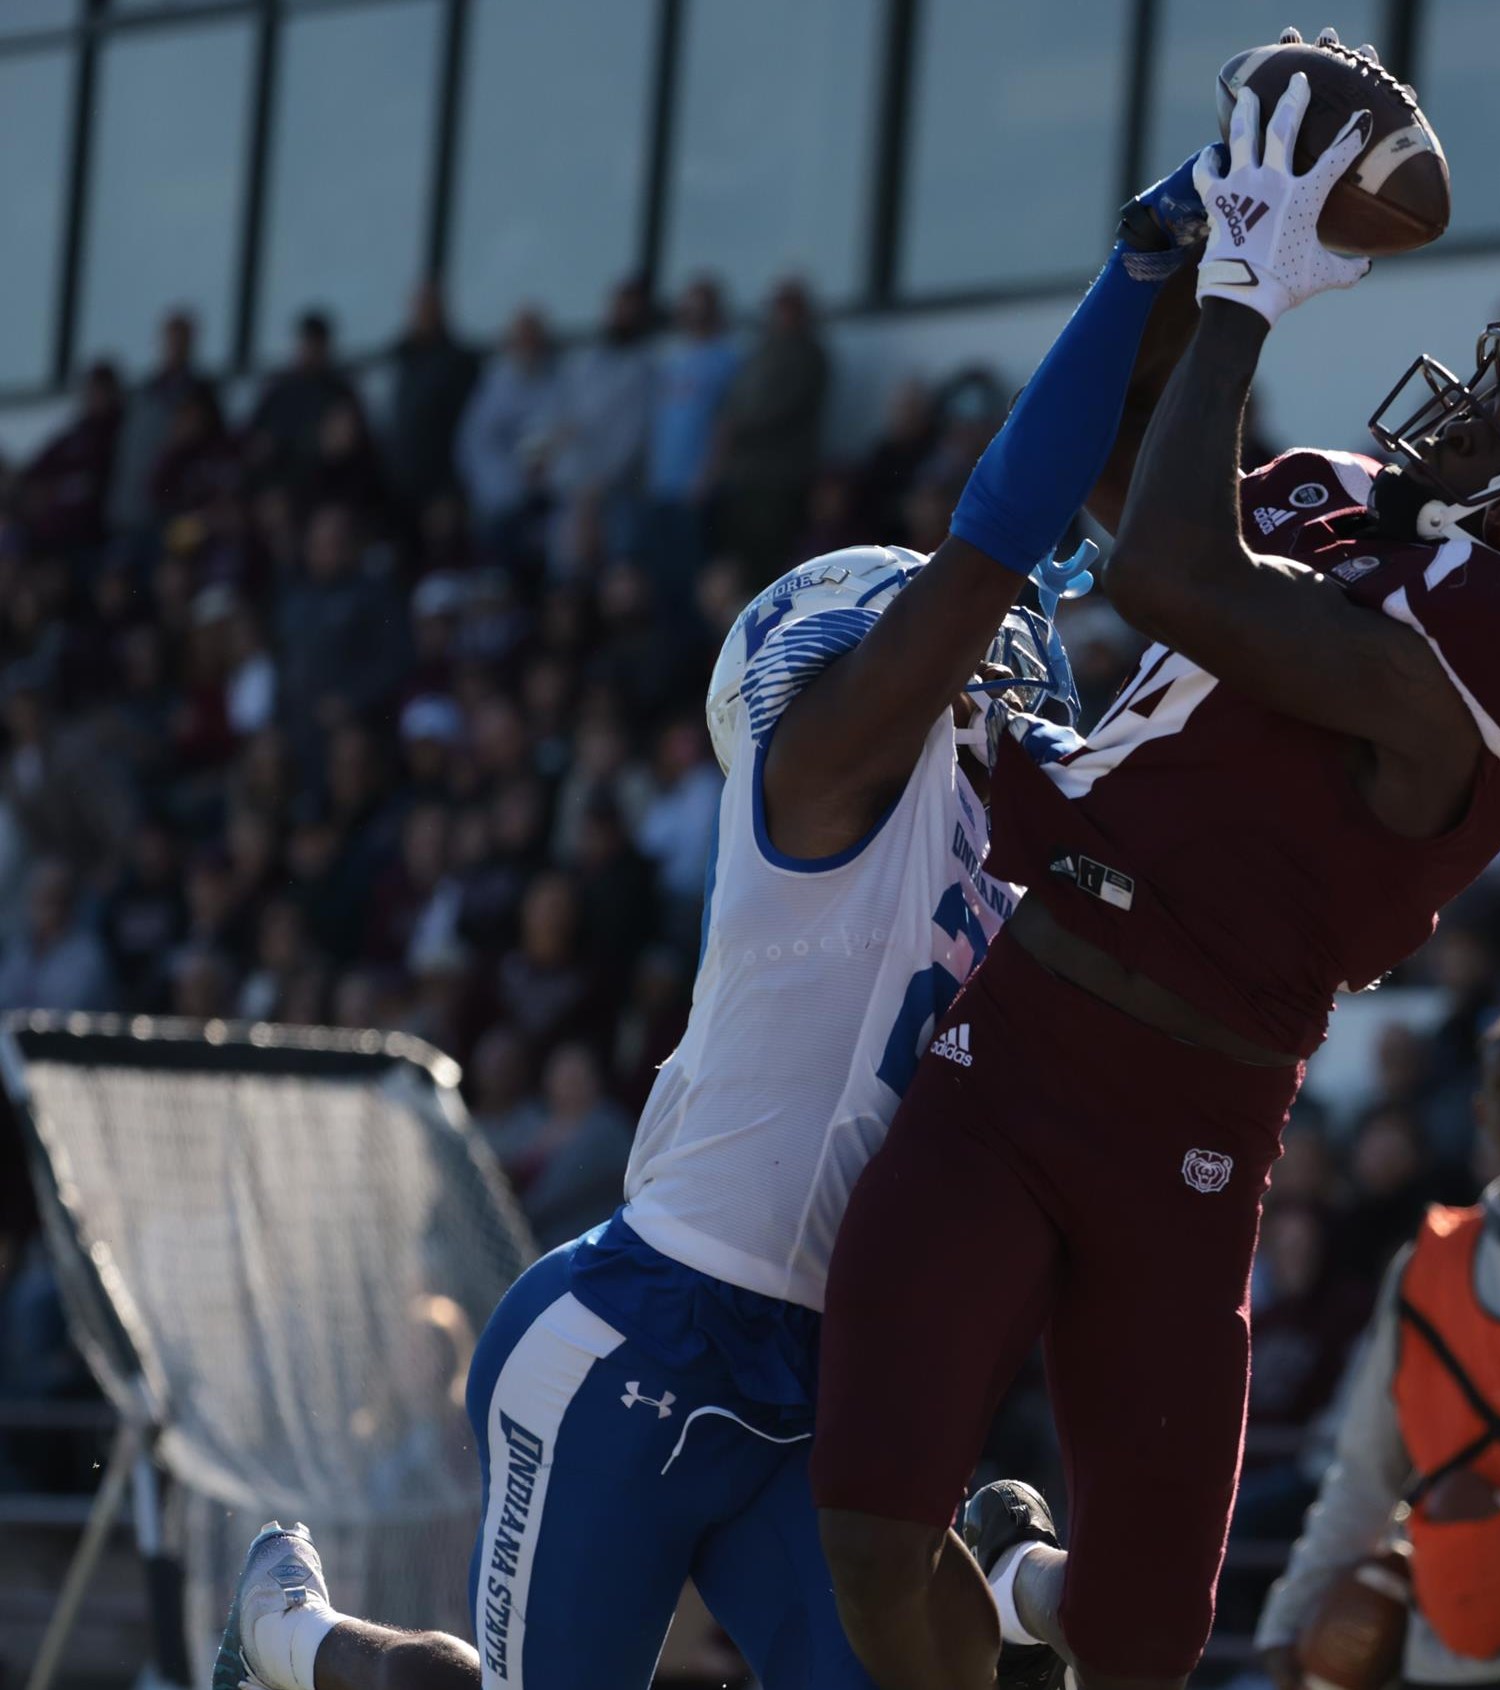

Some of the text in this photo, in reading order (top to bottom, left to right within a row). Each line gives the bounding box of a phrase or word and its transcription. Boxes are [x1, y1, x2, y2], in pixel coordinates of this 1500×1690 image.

[1216, 195, 1247, 247] adidas
[1252, 507, 1276, 536] adidas
[930, 1041, 974, 1068] adidas
[484, 1407, 543, 1681] INDIANA STATE
